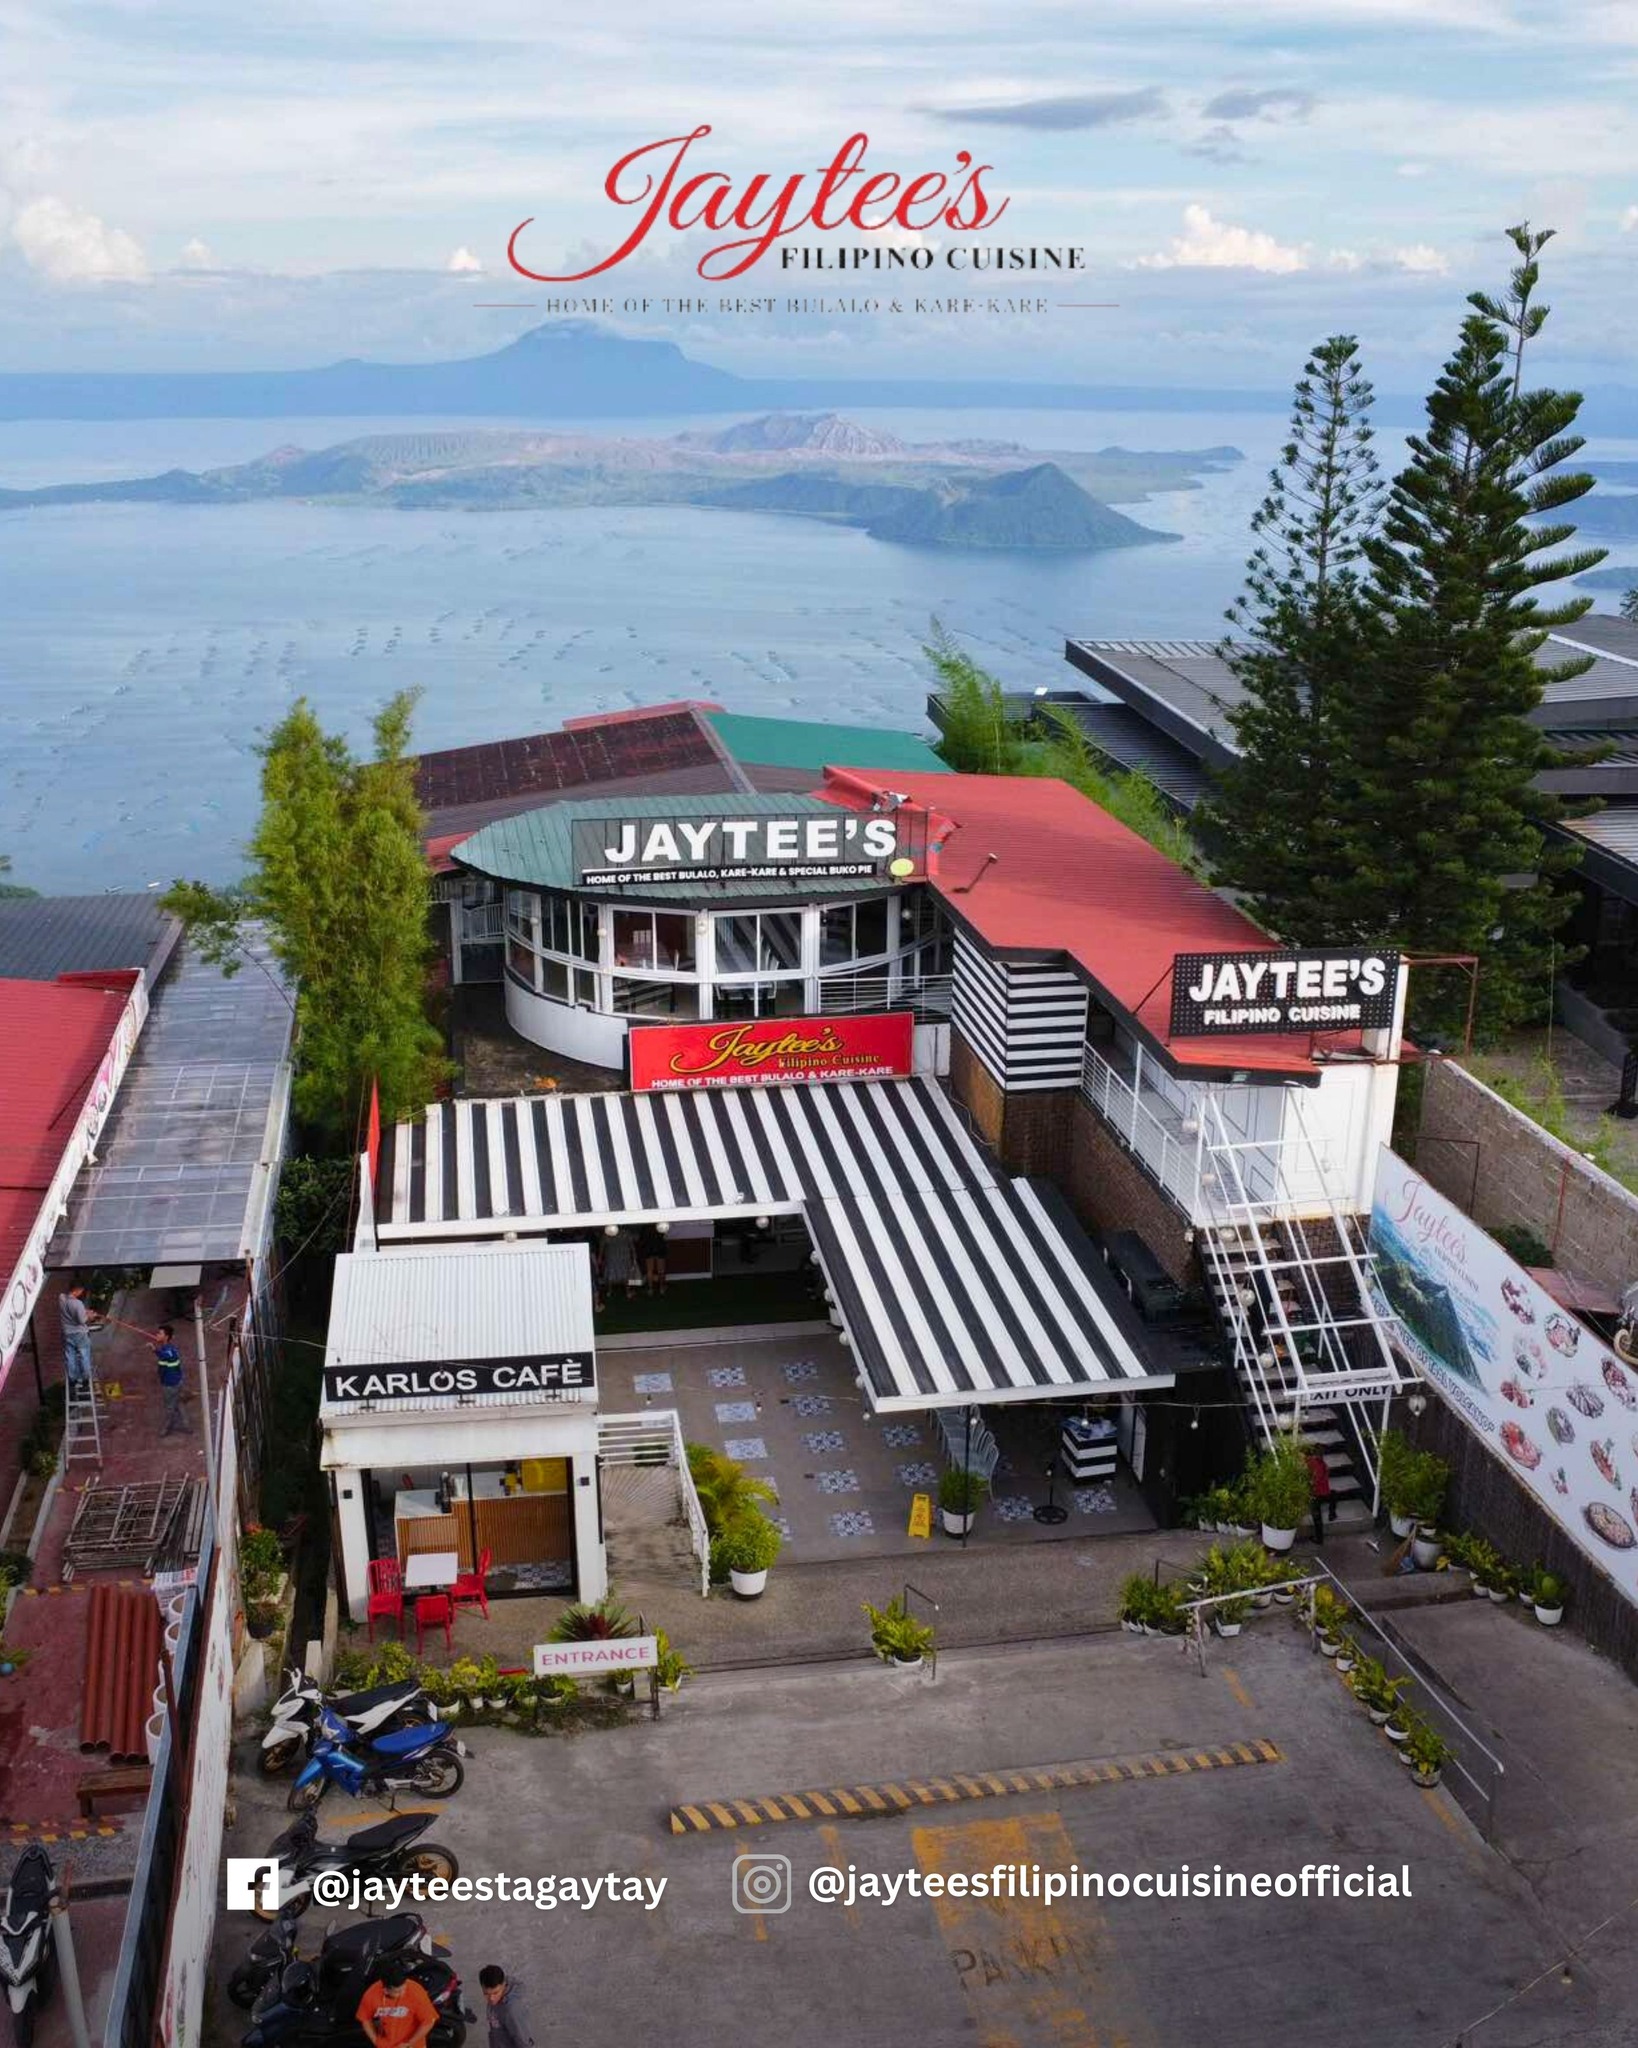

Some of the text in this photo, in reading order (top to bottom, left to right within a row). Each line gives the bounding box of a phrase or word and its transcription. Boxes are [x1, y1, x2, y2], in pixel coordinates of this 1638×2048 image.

[604, 819, 897, 863] JAYTEE'S
[586, 875, 616, 884] HOME
[618, 874, 631, 883] OF
[633, 872, 651, 882] THE
[653, 871, 677, 881] BEST
[721, 868, 777, 878] KARE-KARE
[778, 867, 787, 876] &
[788, 866, 828, 876] SPECIAL
[829, 865, 857, 875] BUKO
[858, 864, 873, 874] PIE
[1189, 958, 1386, 1002] JAYTEE'S
[1204, 1004, 1362, 1025] FILIPINO CUISINE
[669, 1023, 843, 1074] Jaytee's
[651, 1066, 894, 1088] HOME OF THE BEST BULALO & KARE-KARE
[335, 1369, 478, 1397] KARLOS
[1344, 1384, 1389, 1398] ONLY
[541, 1647, 651, 1666] ENTRANCE
